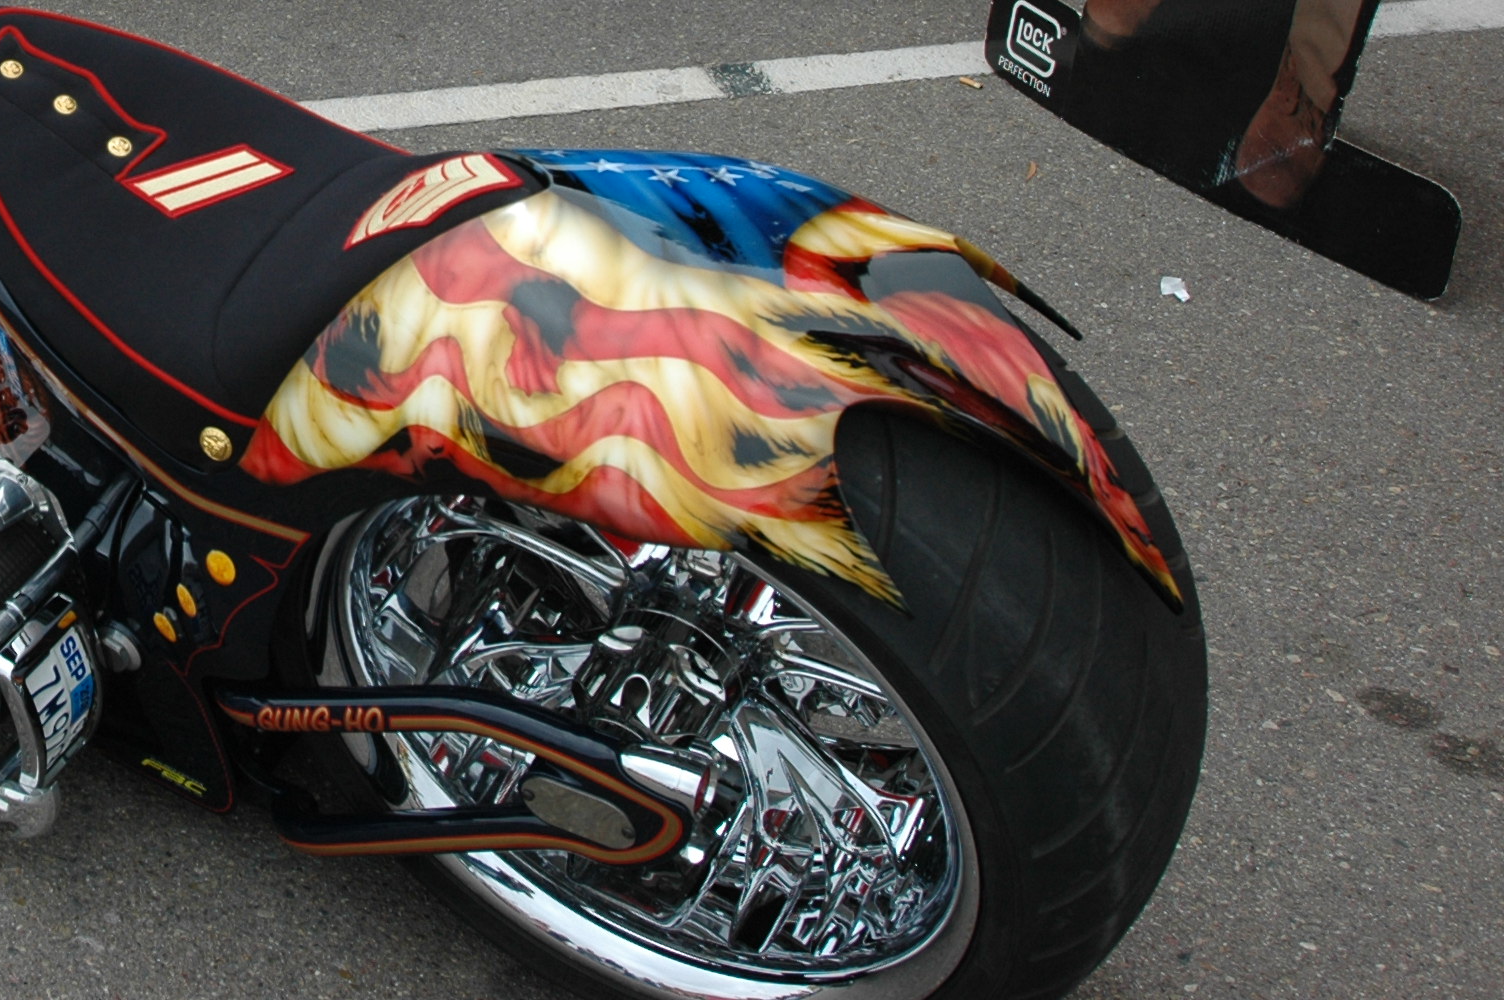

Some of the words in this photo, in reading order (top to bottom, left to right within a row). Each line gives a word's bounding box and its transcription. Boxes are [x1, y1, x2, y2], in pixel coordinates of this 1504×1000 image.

[998, 54, 1051, 98] PERFECTION
[60, 634, 87, 683] SEP
[256, 705, 385, 732] GUNG-HO
